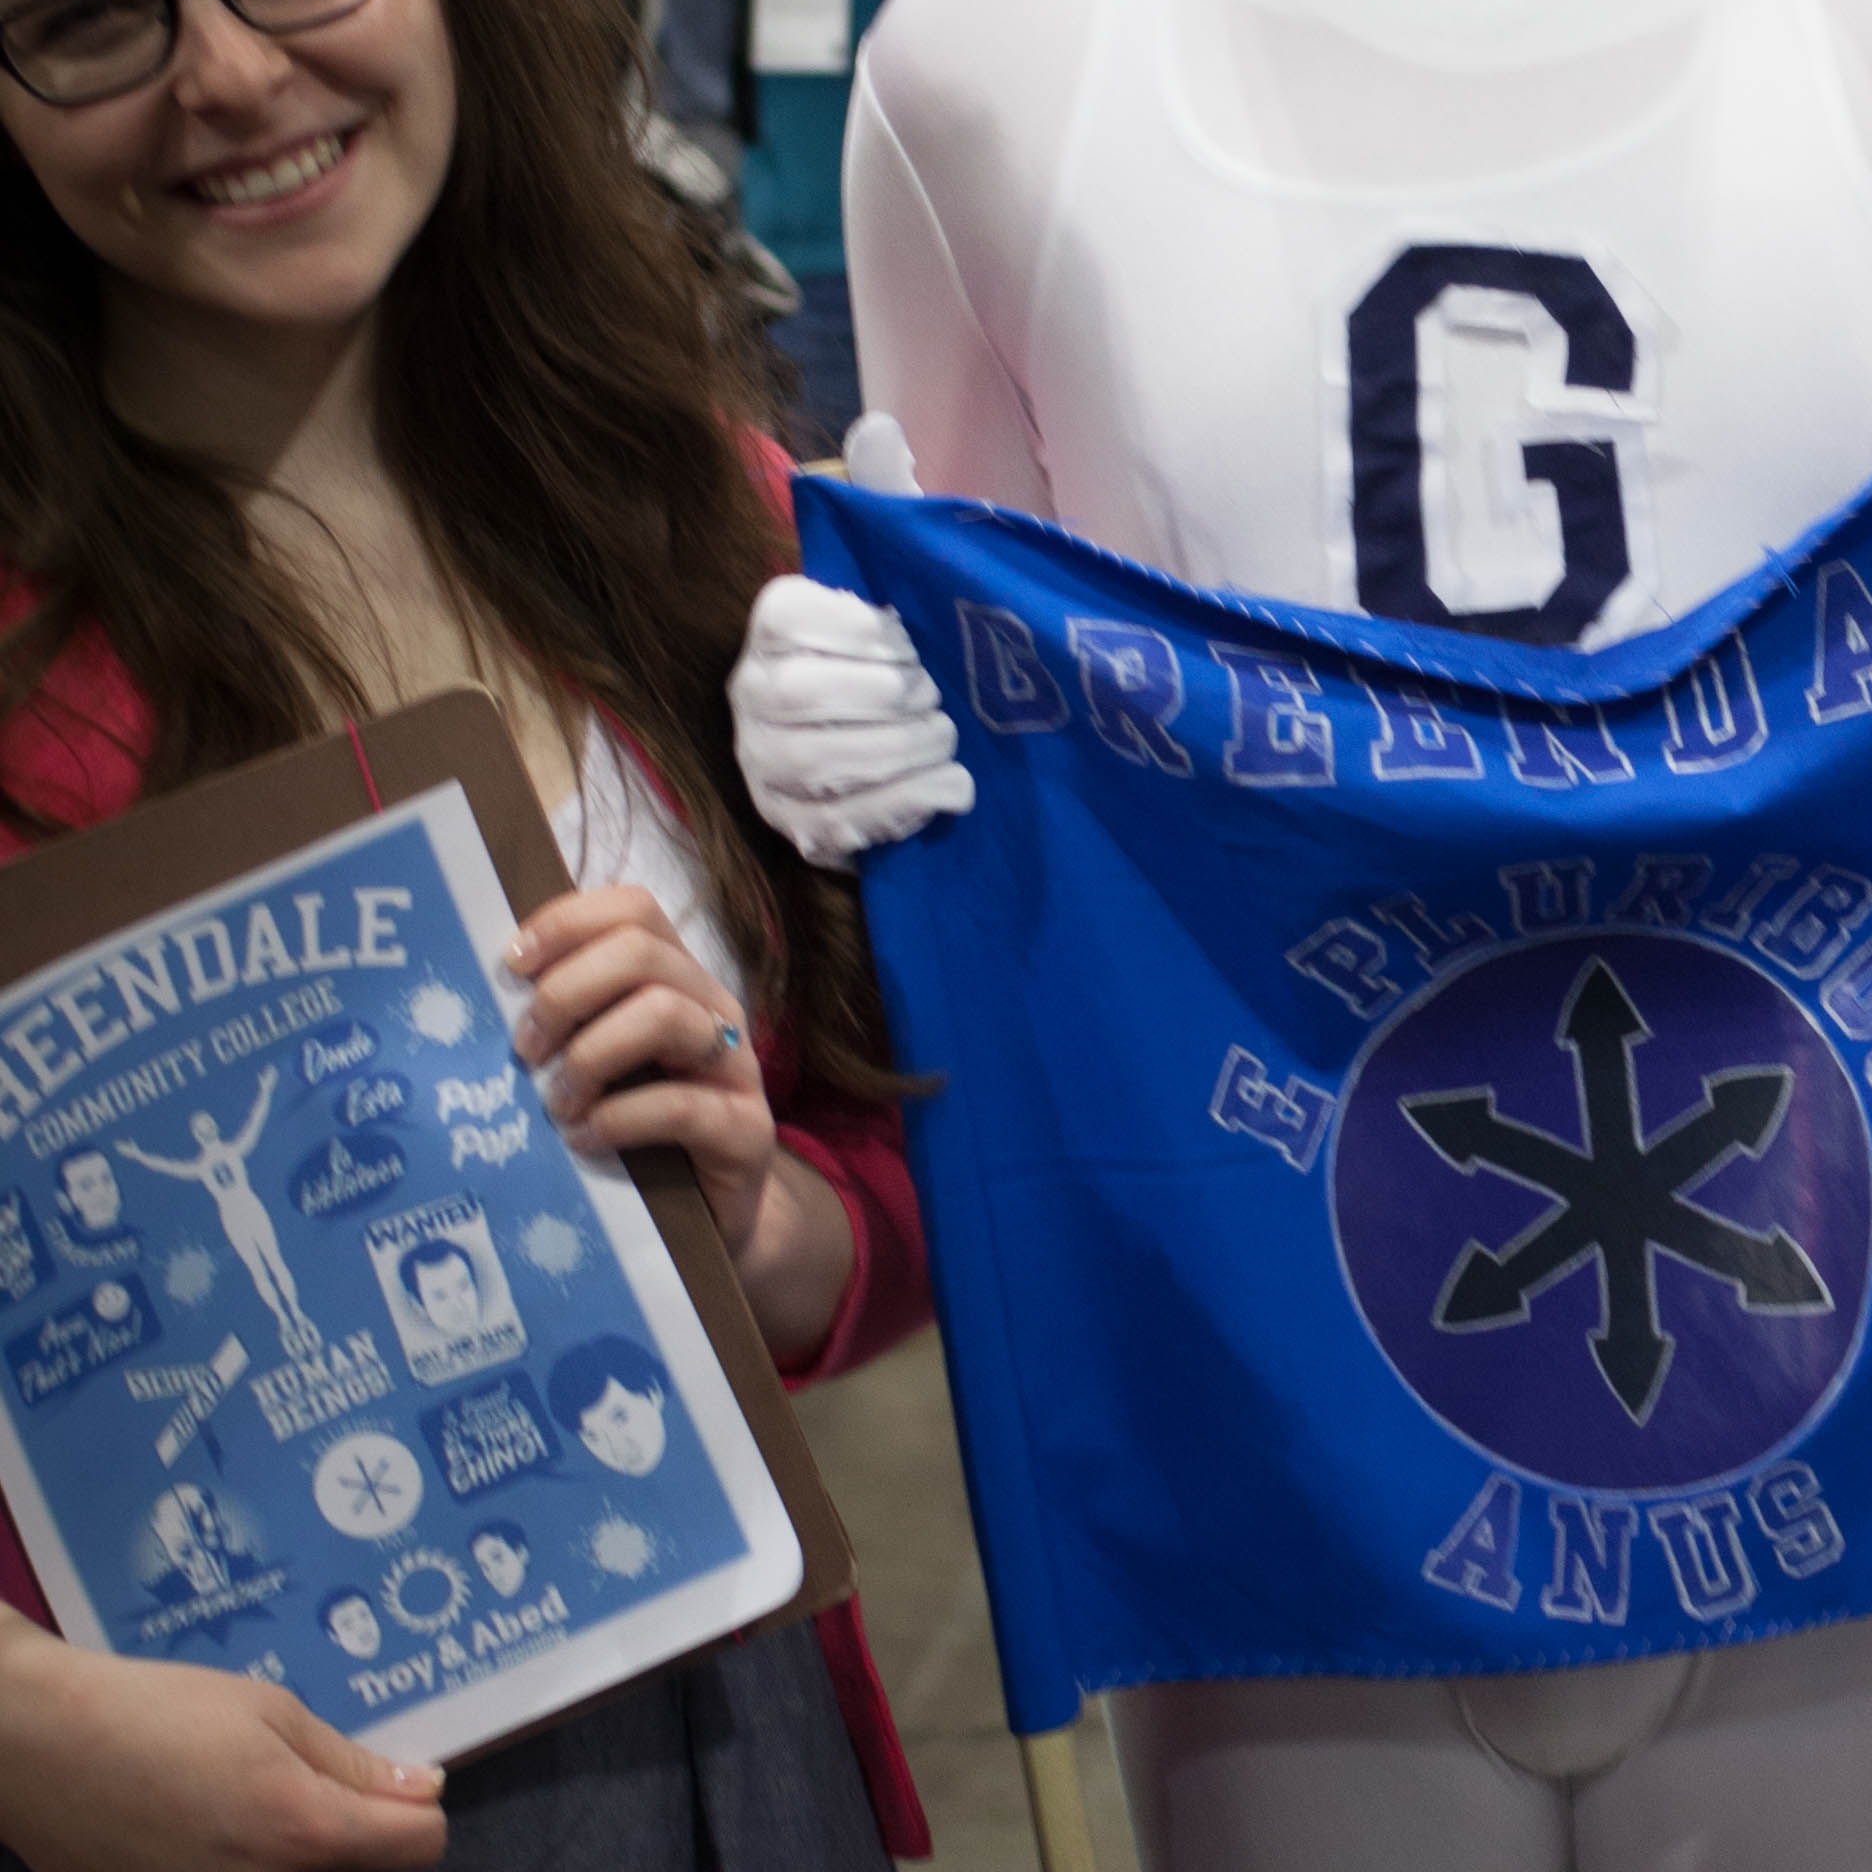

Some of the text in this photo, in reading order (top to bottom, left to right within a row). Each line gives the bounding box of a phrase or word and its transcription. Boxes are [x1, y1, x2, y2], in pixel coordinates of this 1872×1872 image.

[1348, 243, 1636, 648] G
[24, 974, 345, 1162] COMMUNITY COLLEGE
[1208, 1043, 1337, 1174] E
[365, 1186, 485, 1254] WANTED
[248, 1327, 386, 1411] HUMAN
[1422, 1459, 1845, 1626] ANUS
[348, 1651, 434, 1709] Troy
[472, 1583, 571, 1657] Abed
